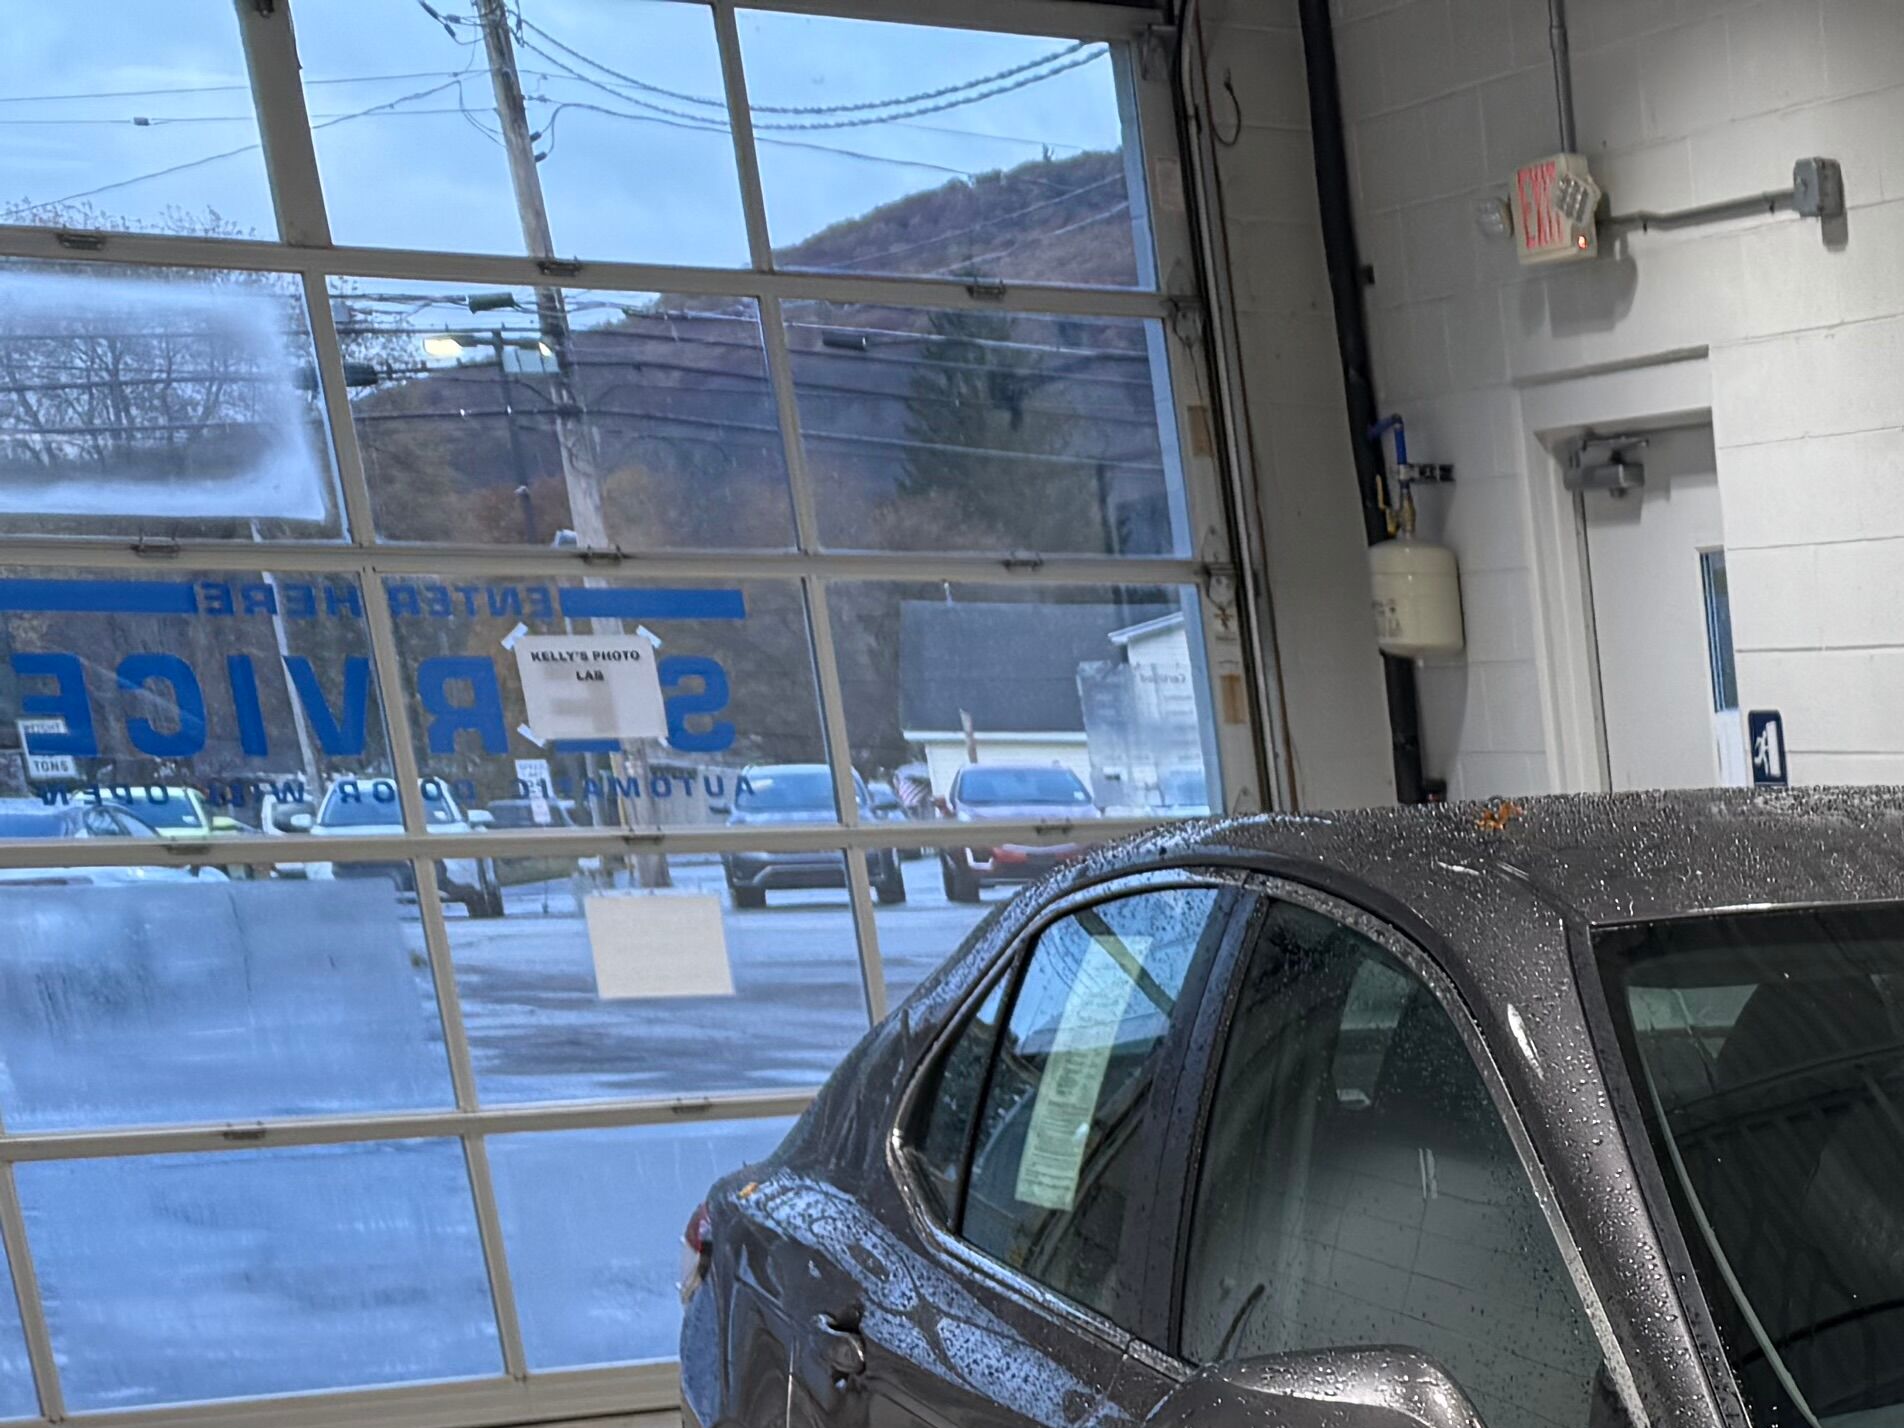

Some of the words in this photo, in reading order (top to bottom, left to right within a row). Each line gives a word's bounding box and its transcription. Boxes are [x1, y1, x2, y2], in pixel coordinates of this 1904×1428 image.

[530, 650, 588, 662] KELLY'S
[592, 650, 641, 662] PHOTO
[575, 669, 605, 681] LAB
[33, 760, 69, 772] TONS
